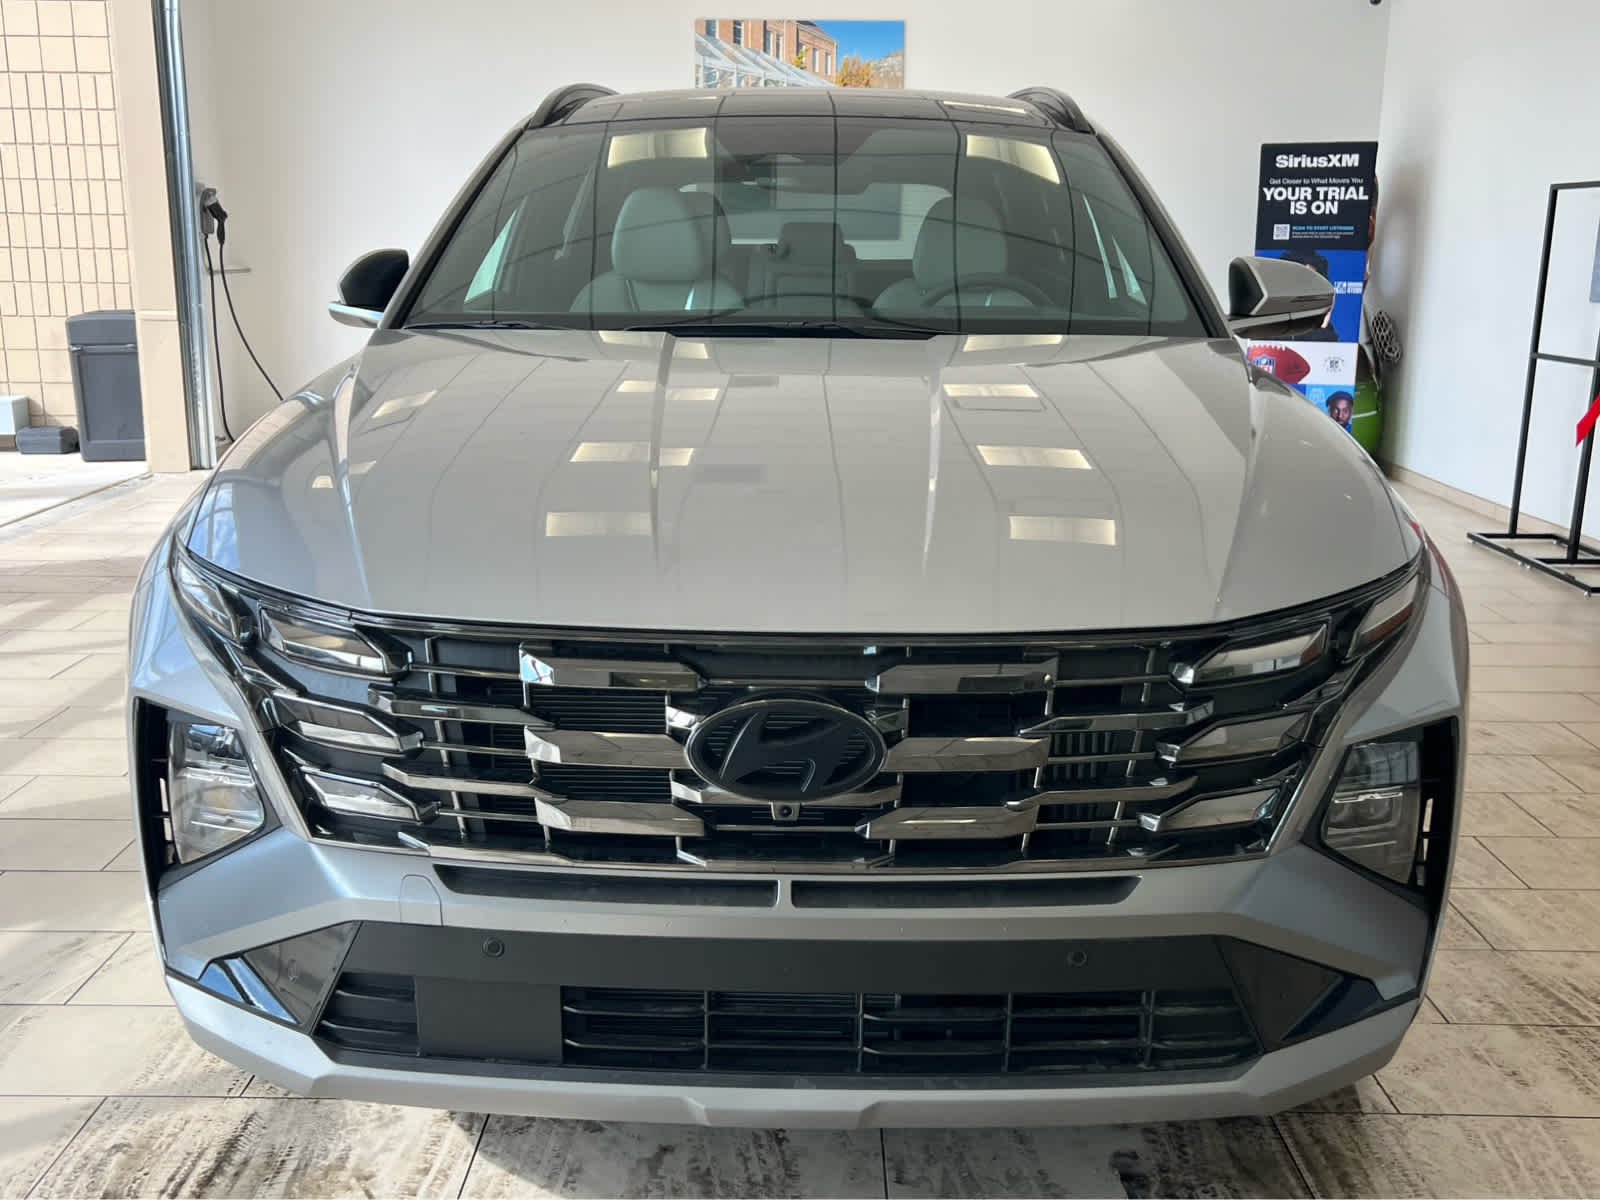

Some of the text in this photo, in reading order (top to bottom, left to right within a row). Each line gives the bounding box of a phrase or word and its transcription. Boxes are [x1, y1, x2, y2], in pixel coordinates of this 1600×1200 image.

[1275, 153, 1360, 168] SiriusXM
[1263, 186, 1369, 201] YOUR TRIAL
[1290, 201, 1338, 215] IS ON
